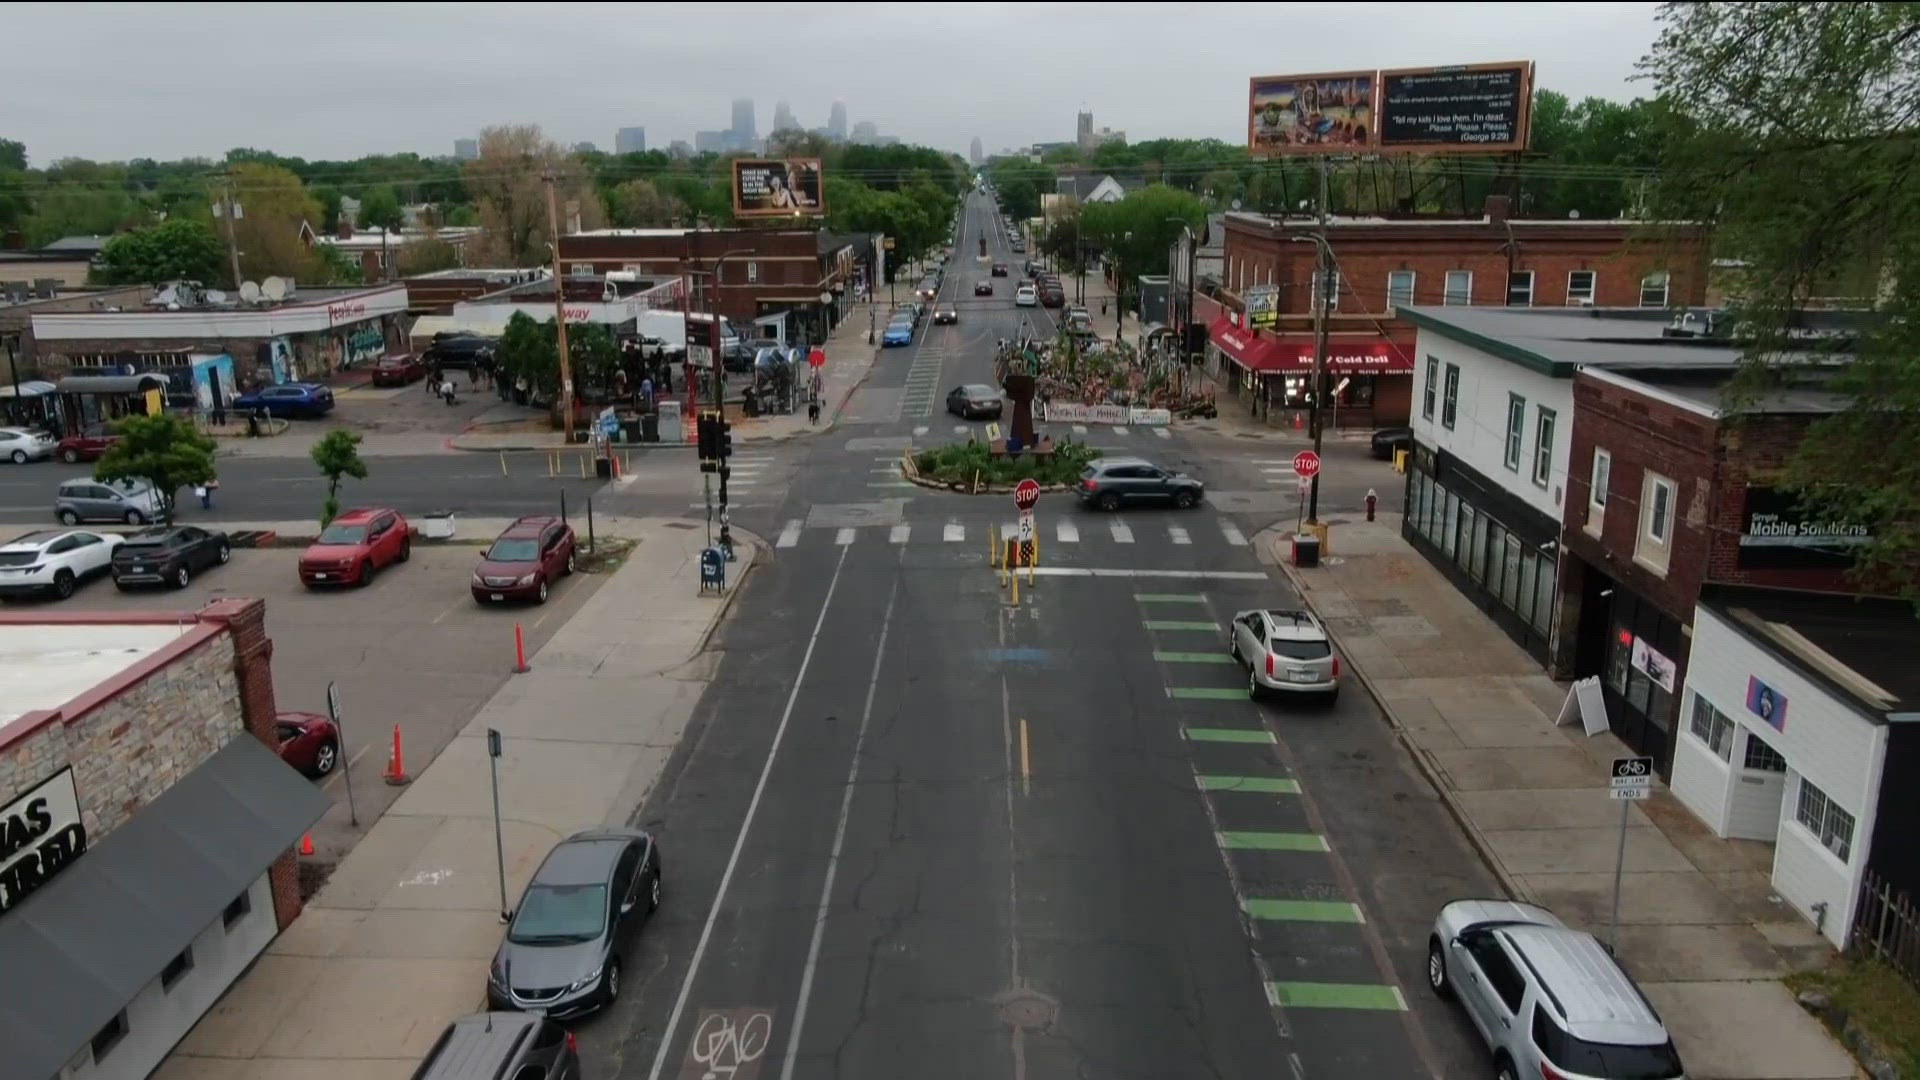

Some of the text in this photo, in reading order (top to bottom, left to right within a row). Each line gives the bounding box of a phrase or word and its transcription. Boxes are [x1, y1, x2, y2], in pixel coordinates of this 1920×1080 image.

[1392, 116, 1406, 125] "Tell
[1406, 116, 1416, 125] my
[1417, 115, 1431, 123] kids
[1437, 114, 1451, 122] love
[1452, 113, 1471, 122] them.
[1473, 113, 1484, 121] I'm
[1461, 133, 1490, 142] (George
[1335, 355, 1362, 363] Cold
[1364, 355, 1389, 363] Deli
[1294, 458, 1318, 470] STOP
[1016, 487, 1038, 502] STOP
[1751, 512, 1778, 523] Simple
[1750, 521, 1797, 535] Mobile
[1617, 789, 1641, 797] ENDS
